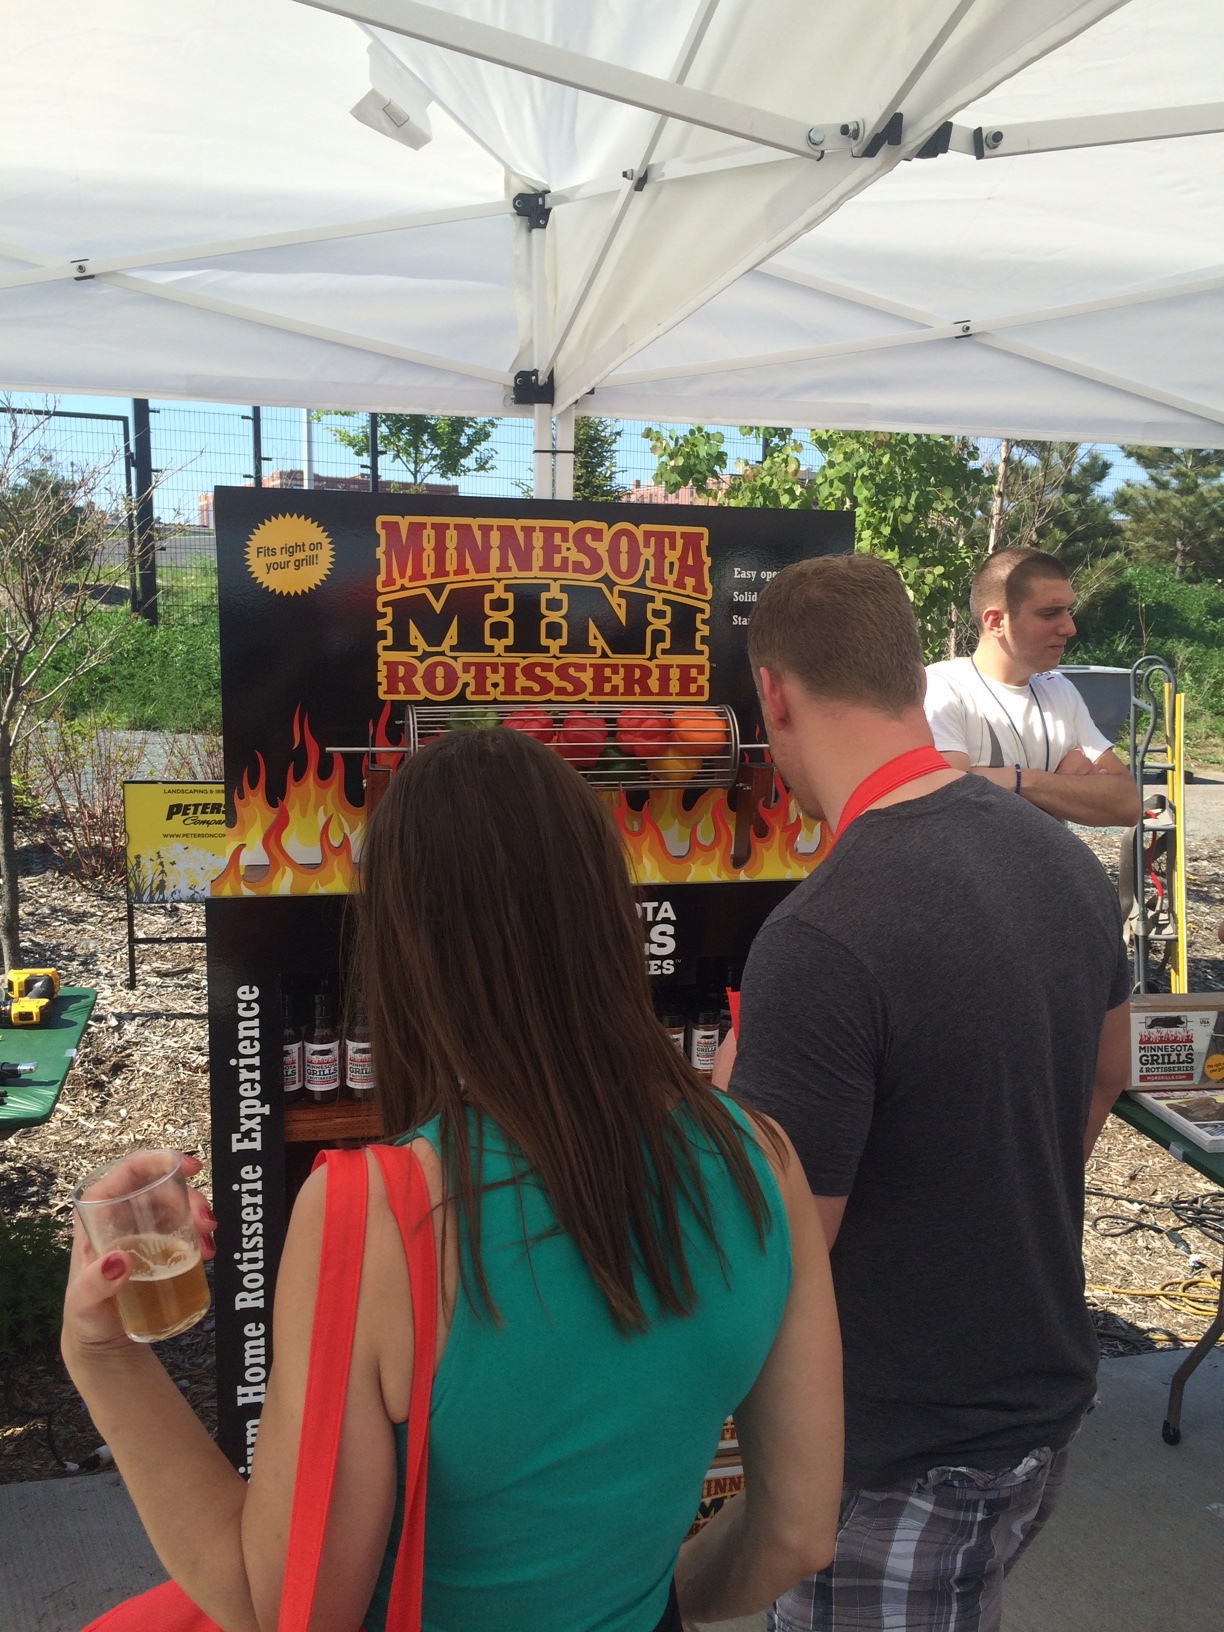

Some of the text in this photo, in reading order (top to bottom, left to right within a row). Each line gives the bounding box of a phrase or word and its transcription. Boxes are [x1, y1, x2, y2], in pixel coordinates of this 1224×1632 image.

[256, 541, 323, 558] Fits right on
[378, 518, 711, 598] MINNESOTA
[265, 554, 319, 574] your grill!
[733, 568, 780, 581] Easy ope
[733, 591, 758, 602] Solid
[380, 582, 708, 656] MINI
[381, 659, 707, 698] ROTISSERIE
[1139, 1045, 1194, 1053] MINNESOTA
[229, 985, 271, 1153] Experience
[1139, 1053, 1194, 1066] GRILLS
[306, 1068, 338, 1077] GRILLS
[231, 1164, 265, 1311] Rotisserie
[236, 1322, 267, 1407] Home
